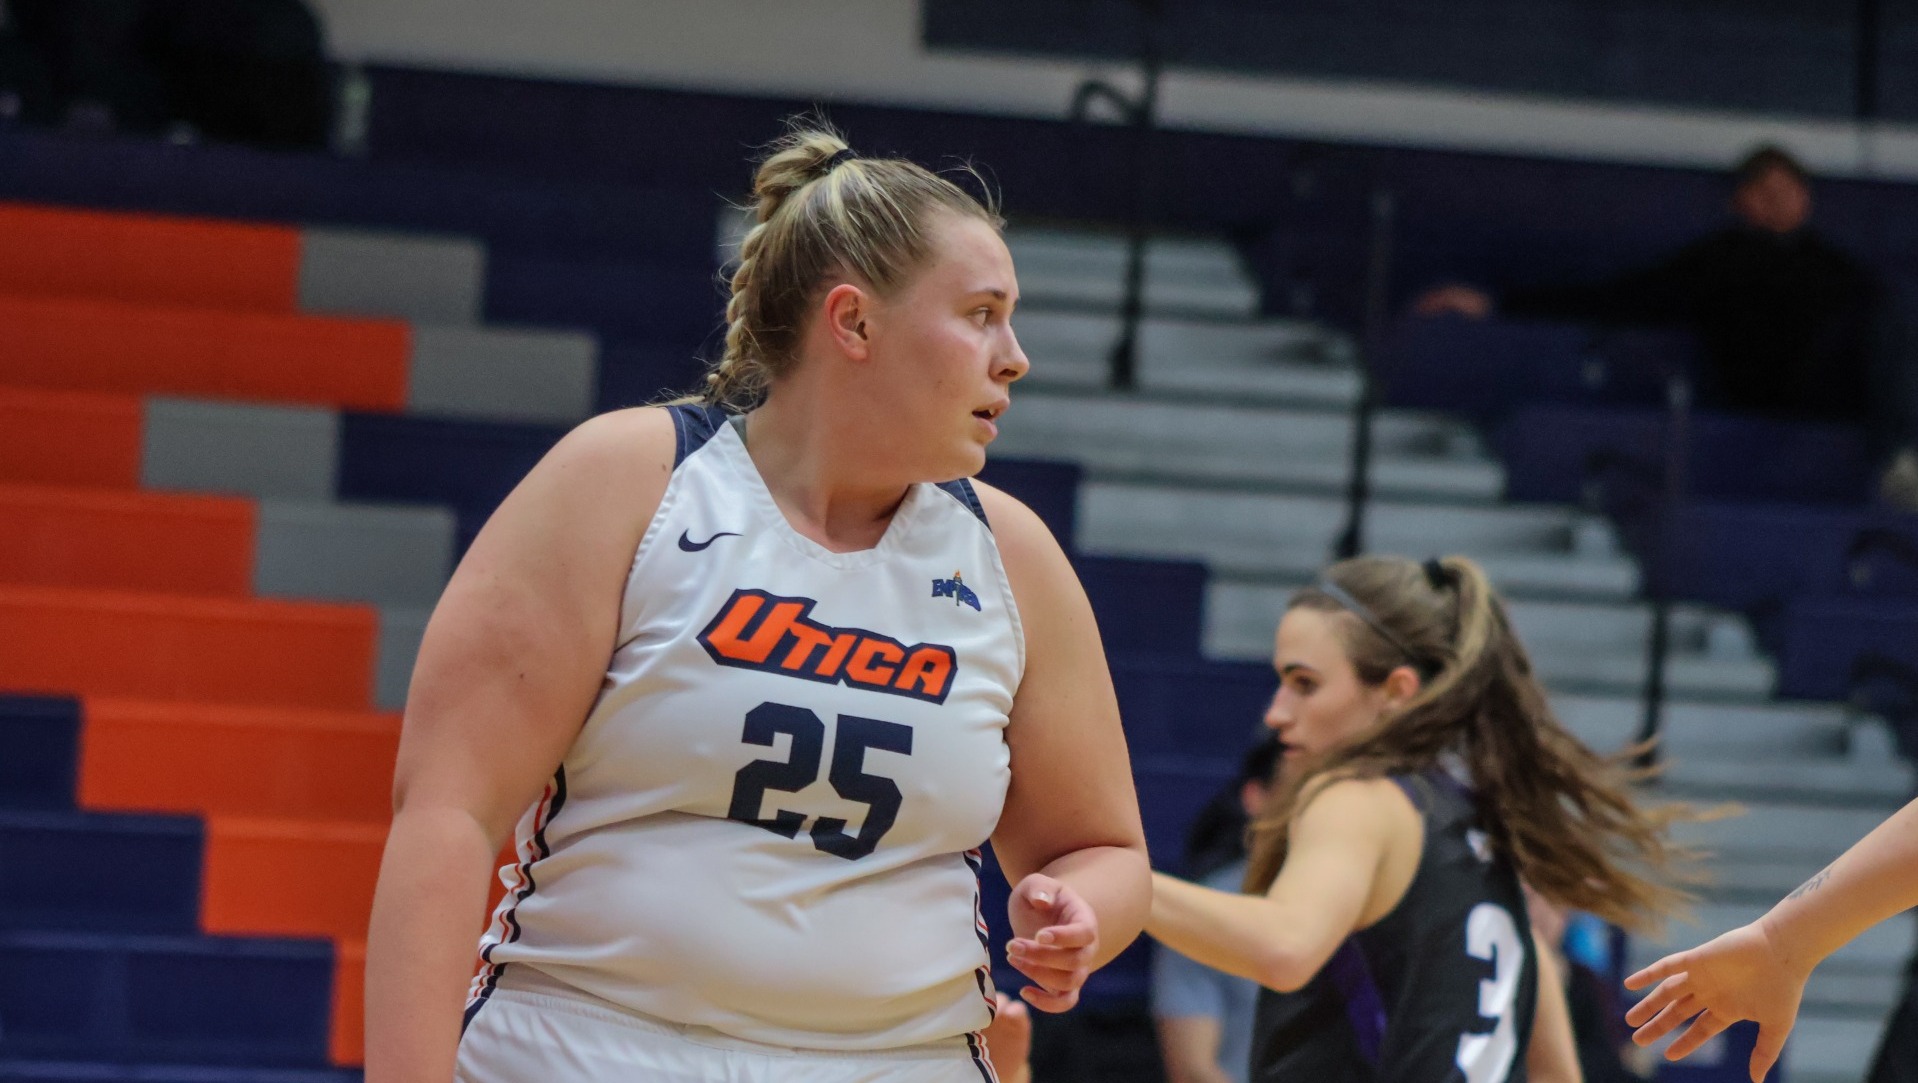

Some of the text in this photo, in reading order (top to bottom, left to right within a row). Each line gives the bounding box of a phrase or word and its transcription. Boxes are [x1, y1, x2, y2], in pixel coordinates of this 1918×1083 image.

[702, 592, 955, 700] UTICA
[728, 702, 913, 861] 25
[1456, 902, 1525, 1083] 3
